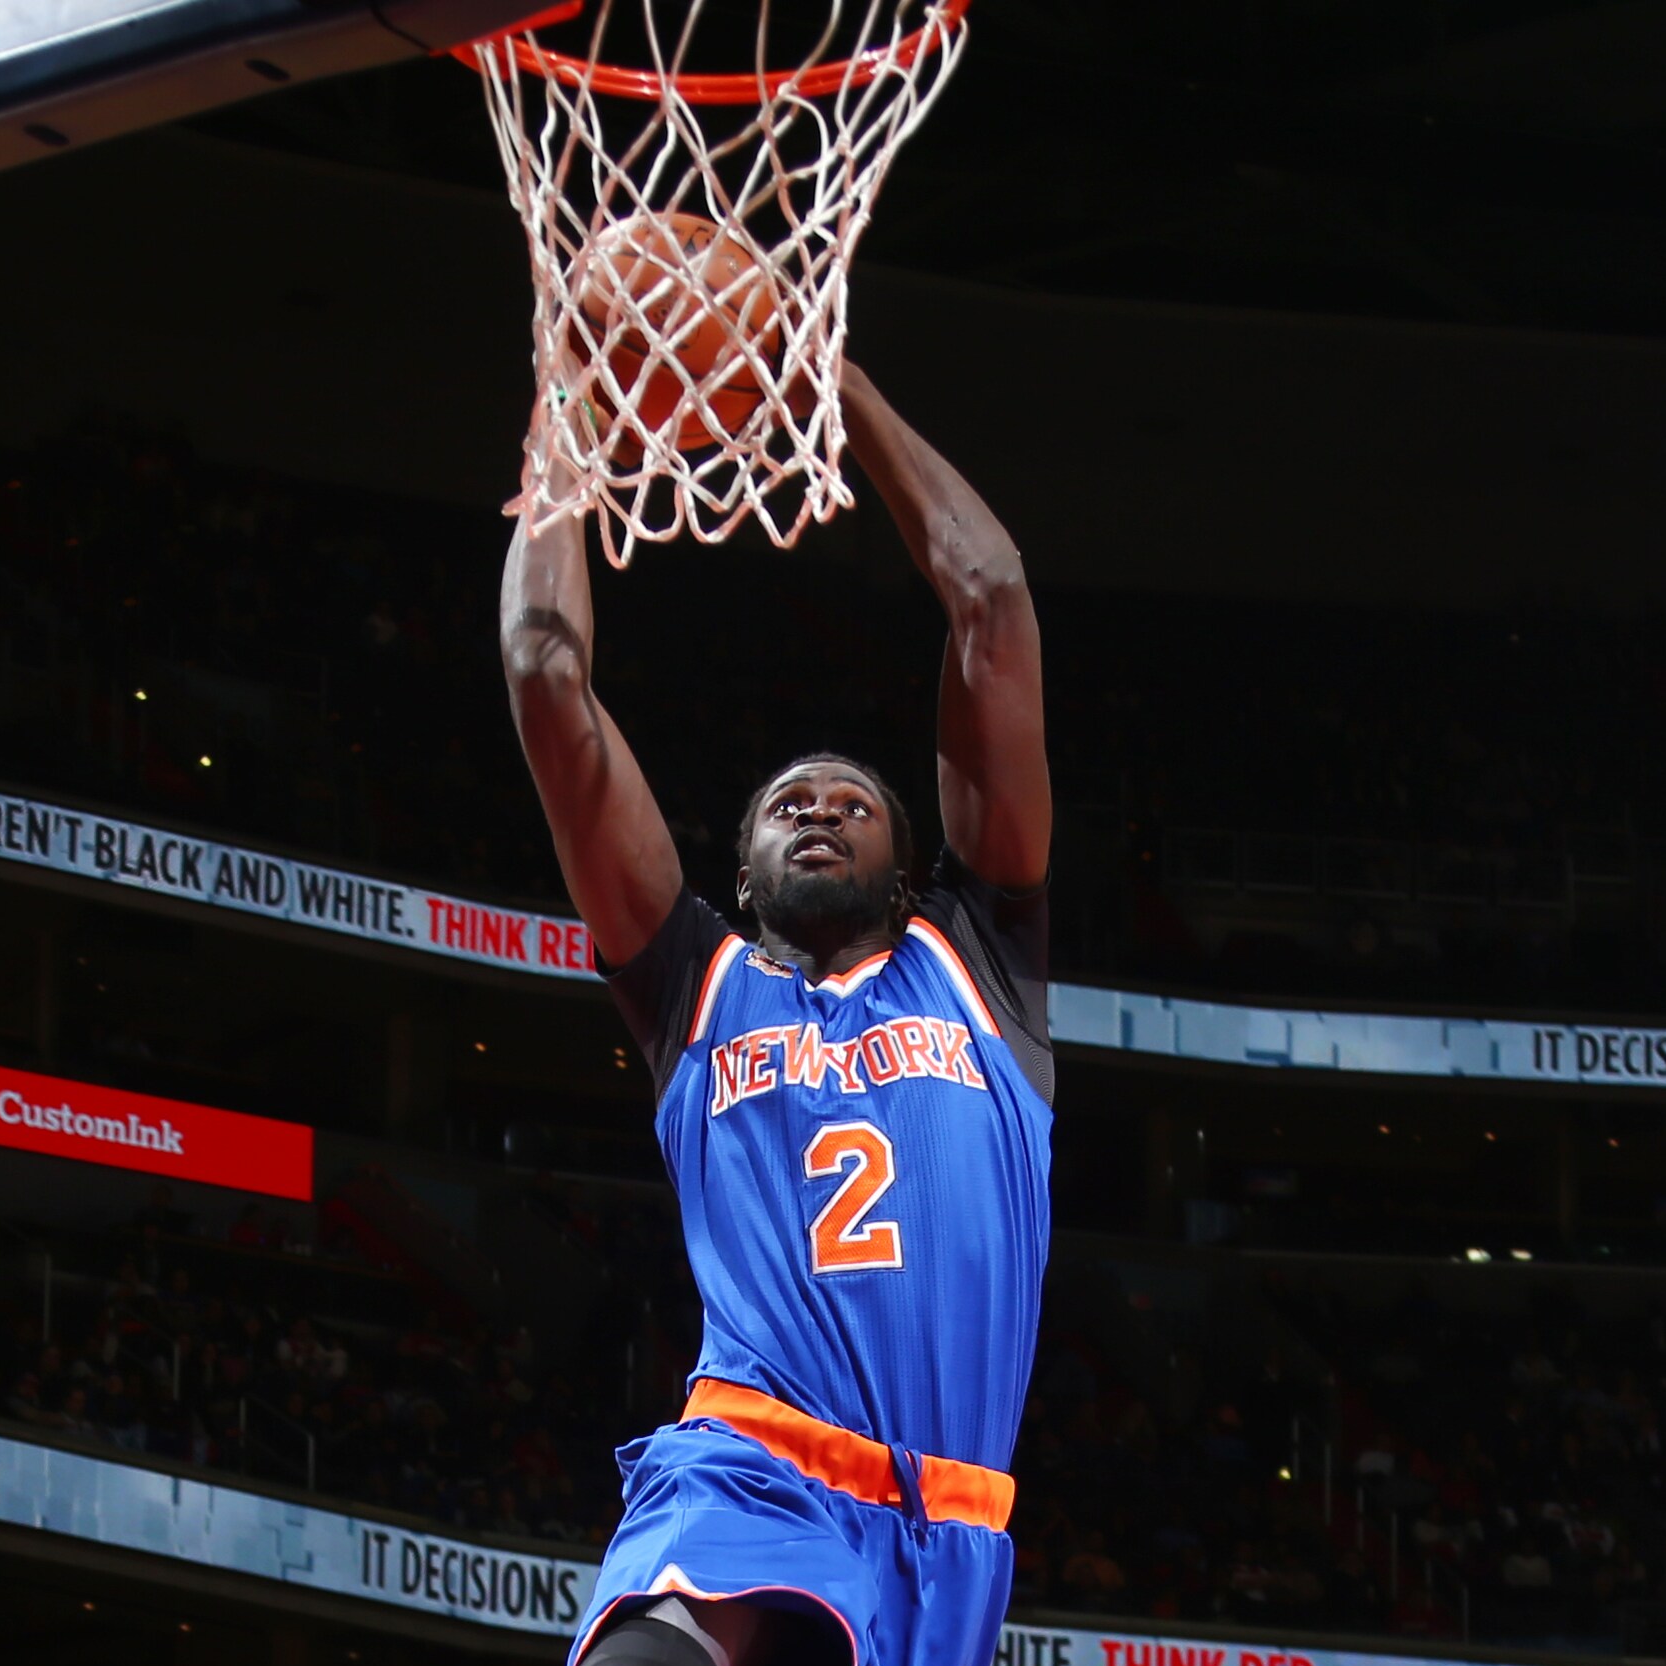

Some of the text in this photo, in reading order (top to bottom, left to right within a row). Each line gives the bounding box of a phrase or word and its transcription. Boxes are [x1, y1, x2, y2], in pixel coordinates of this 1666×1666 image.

[94, 824, 204, 890] BLACK
[214, 852, 285, 908] AND
[296, 868, 414, 938] WHITE.
[426, 897, 528, 963] THINK
[711, 1015, 989, 1118] NEW YORK
[1533, 1028, 1563, 1072] IT
[803, 1120, 905, 1275] 2
[362, 1528, 580, 1624] IT DECISIONS
